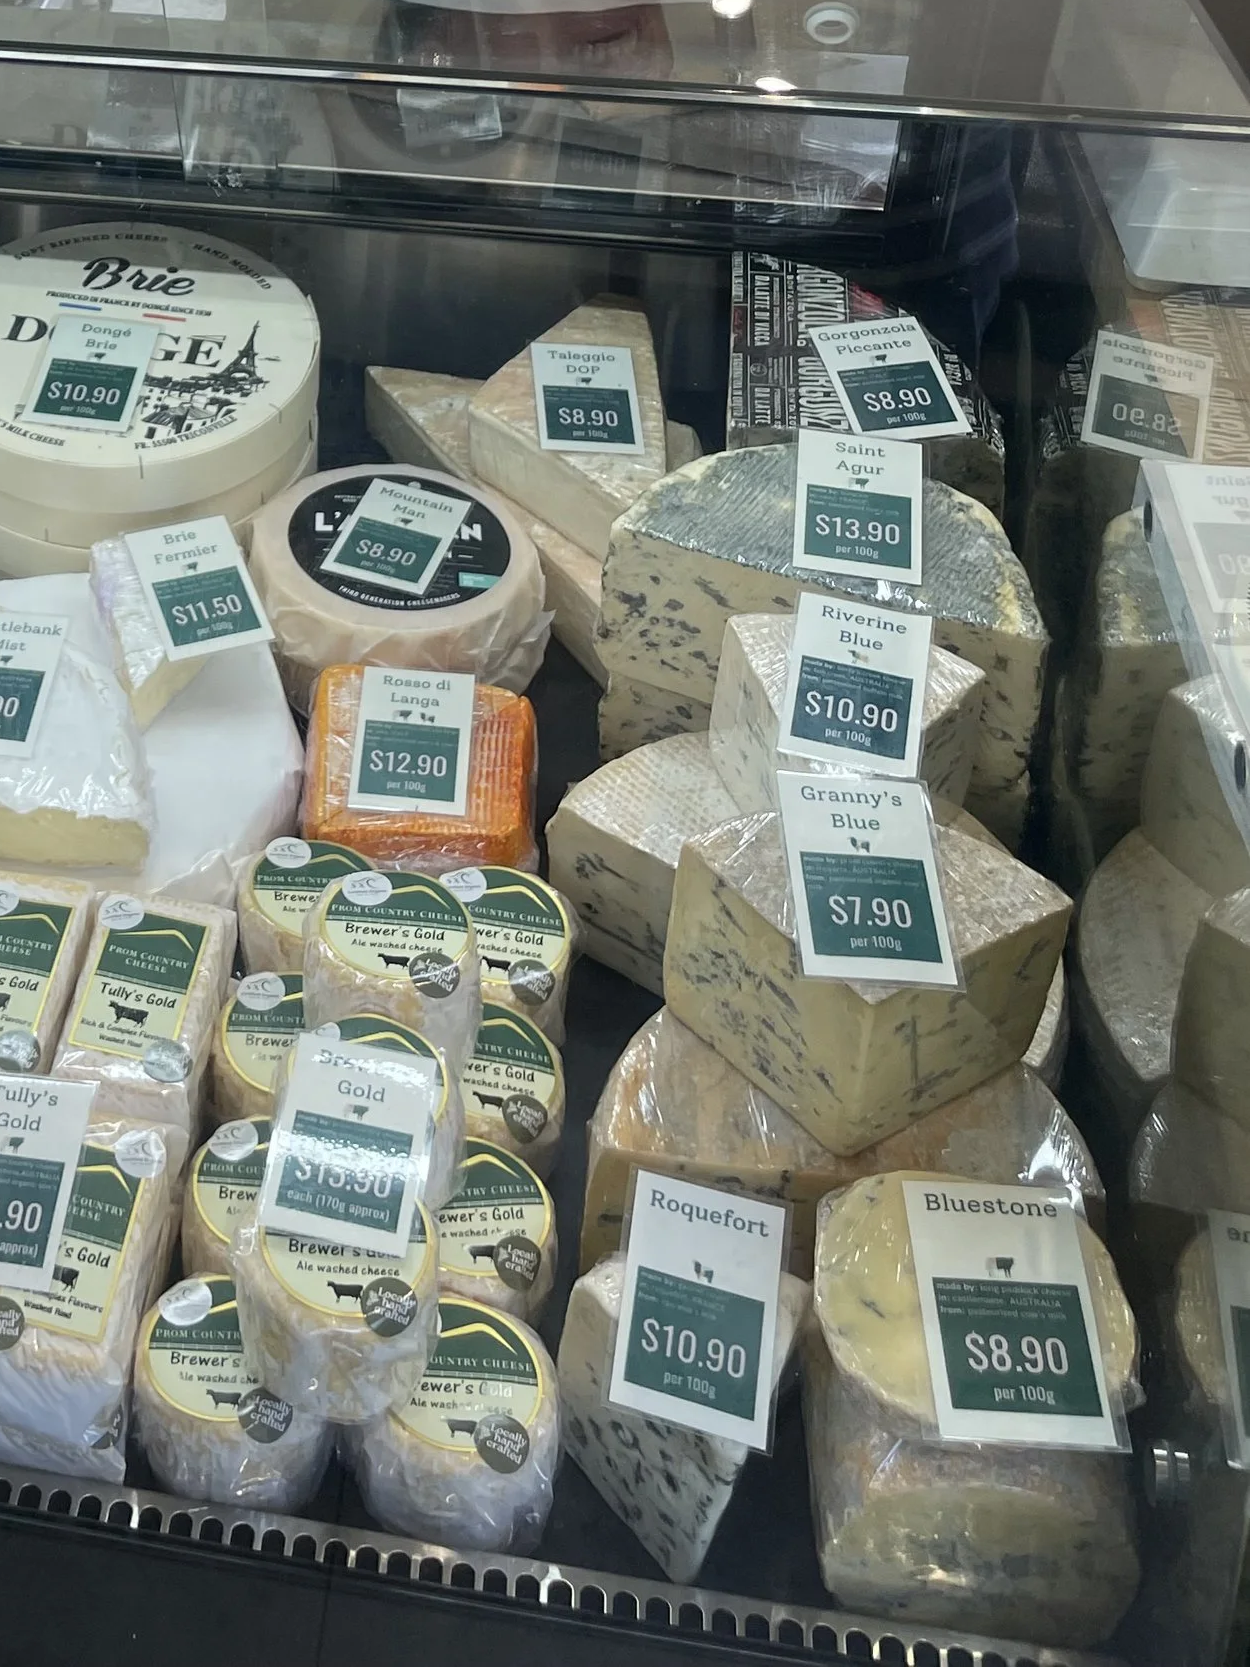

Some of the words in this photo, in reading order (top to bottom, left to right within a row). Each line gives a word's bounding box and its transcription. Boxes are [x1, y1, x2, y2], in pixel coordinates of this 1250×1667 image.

[50, 234, 110, 249] RIPENED
[82, 256, 195, 296] Brie
[192, 243, 230, 260] HAND
[230, 259, 273, 290] MOLDED
[46, 290, 89, 303] PRODUCED
[82, 323, 132, 338] Dongé
[817, 323, 917, 343] Gorgonzola
[85, 338, 117, 350] Brie
[836, 338, 912, 355] Piccante
[547, 350, 616, 363] Taleggio
[566, 364, 600, 374] DOP
[48, 382, 121, 405] $10.90
[863, 387, 932, 412] $8.90
[558, 407, 618, 427] $8.90
[835, 441, 886, 458] Saint
[835, 460, 885, 476] Agur
[379, 486, 453, 513] Mountain
[392, 503, 426, 519] Man
[163, 531, 197, 545] Brie
[815, 514, 900, 545] $13.90
[154, 544, 218, 565] Fermier
[356, 539, 417, 566] $8.90
[172, 594, 243, 626] $11.50
[822, 605, 908, 636] Riverine
[839, 630, 884, 651] Blue
[383, 675, 431, 689] Rosso
[436, 678, 451, 691] di
[391, 692, 440, 707] Langa
[805, 690, 898, 733] $10.90
[845, 728, 872, 747] 100g
[369, 749, 447, 777] $12.90
[800, 785, 902, 809] Granny's
[832, 813, 881, 831] Blue
[331, 903, 361, 914] PROM
[365, 906, 416, 918] COUNTRY
[419, 909, 465, 923] CHEESE
[519, 911, 562, 926] CHEESE
[829, 894, 912, 929] $7.90
[345, 923, 410, 939] Brewer's
[413, 928, 445, 941] Gold
[515, 931, 544, 946] Gold
[5, 935, 53, 951] COUNTRY
[369, 941, 406, 951] washed
[408, 943, 443, 954] cheese
[872, 936, 902, 952] 100g
[109, 944, 138, 958] PROM
[140, 952, 190, 969] COUNTRY
[125, 957, 167, 974] CHEESE
[9, 977, 39, 991] Gold
[101, 982, 143, 1003] Tully's
[146, 994, 176, 1009] Gold
[505, 1048, 549, 1063] CHEESE
[505, 1067, 535, 1083] Gold
[338, 1080, 385, 1103] Gold
[490, 1184, 536, 1195] CHEESE
[72, 1195, 126, 1217] COUNTRY
[287, 1188, 313, 1205] each
[315, 1194, 346, 1214] (170g
[348, 1201, 390, 1222] approx)
[492, 1207, 525, 1221] Gold
[650, 1189, 770, 1237] Roquefort
[924, 1192, 1058, 1218] Bluestone
[0, 1240, 39, 1258] approx)
[288, 1238, 361, 1257] Brewer's
[77, 1249, 110, 1268] Gold
[296, 1260, 316, 1272] Ale
[318, 1262, 359, 1275] washed
[361, 1266, 400, 1277] cheese
[936, 1281, 960, 1291] made
[378, 1287, 416, 1309] Locally
[1009, 1297, 1062, 1308] AUSTRALIA
[940, 1305, 965, 1315] from:
[156, 1328, 188, 1339] PROM
[641, 1315, 747, 1379] $10.90
[965, 1330, 1069, 1375] $8.90
[170, 1352, 240, 1368] Brewer's
[482, 1358, 533, 1373] CHEESE
[663, 1371, 683, 1386] per
[687, 1375, 717, 1399] 100g
[994, 1385, 1015, 1401] per
[1019, 1384, 1056, 1406] 100g
[254, 1395, 291, 1416] Locally
[258, 1406, 283, 1421] hand
[250, 1413, 286, 1432] crafted
[491, 1423, 526, 1446] Locally
[493, 1433, 520, 1451] hand
[486, 1441, 522, 1464] crafted
